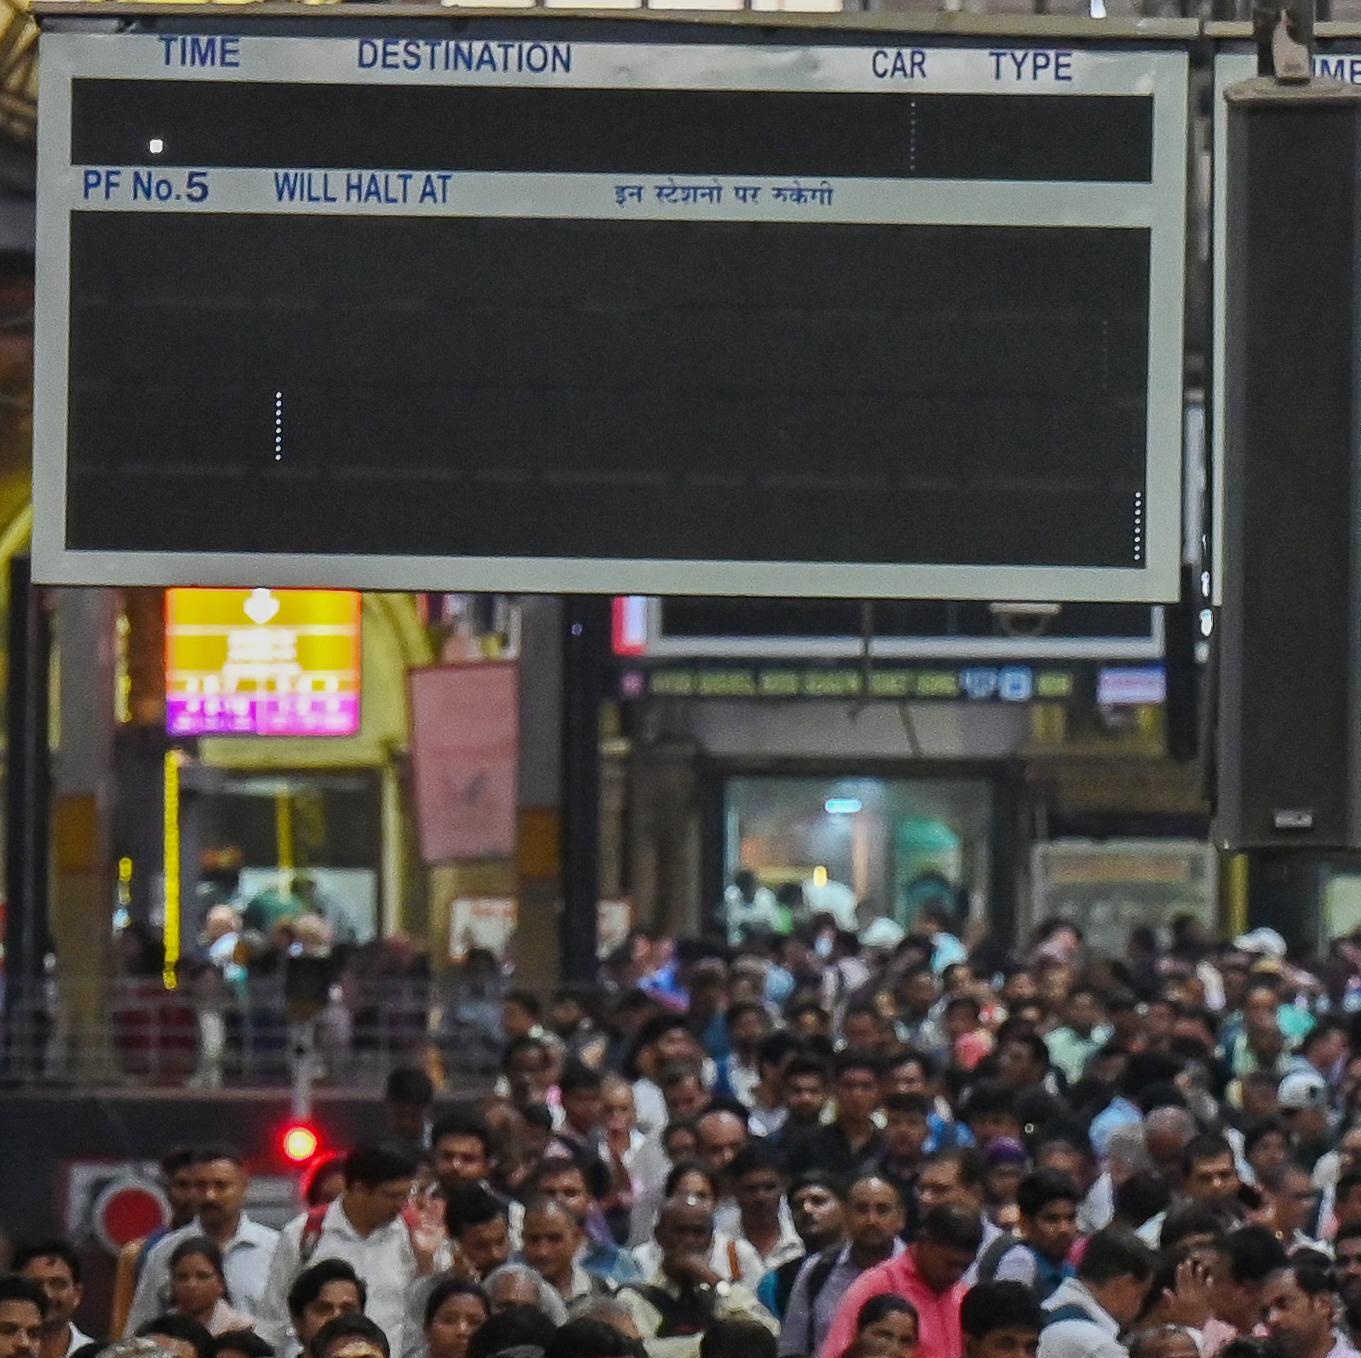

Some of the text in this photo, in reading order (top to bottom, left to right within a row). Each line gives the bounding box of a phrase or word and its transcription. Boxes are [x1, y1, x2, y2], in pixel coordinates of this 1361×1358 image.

[159, 35, 1073, 81] TIME DESTINATION CAR TYPE
[83, 170, 121, 199] PF
[274, 172, 337, 202] WILL
[346, 174, 412, 203] HALT
[419, 174, 452, 202] AT
